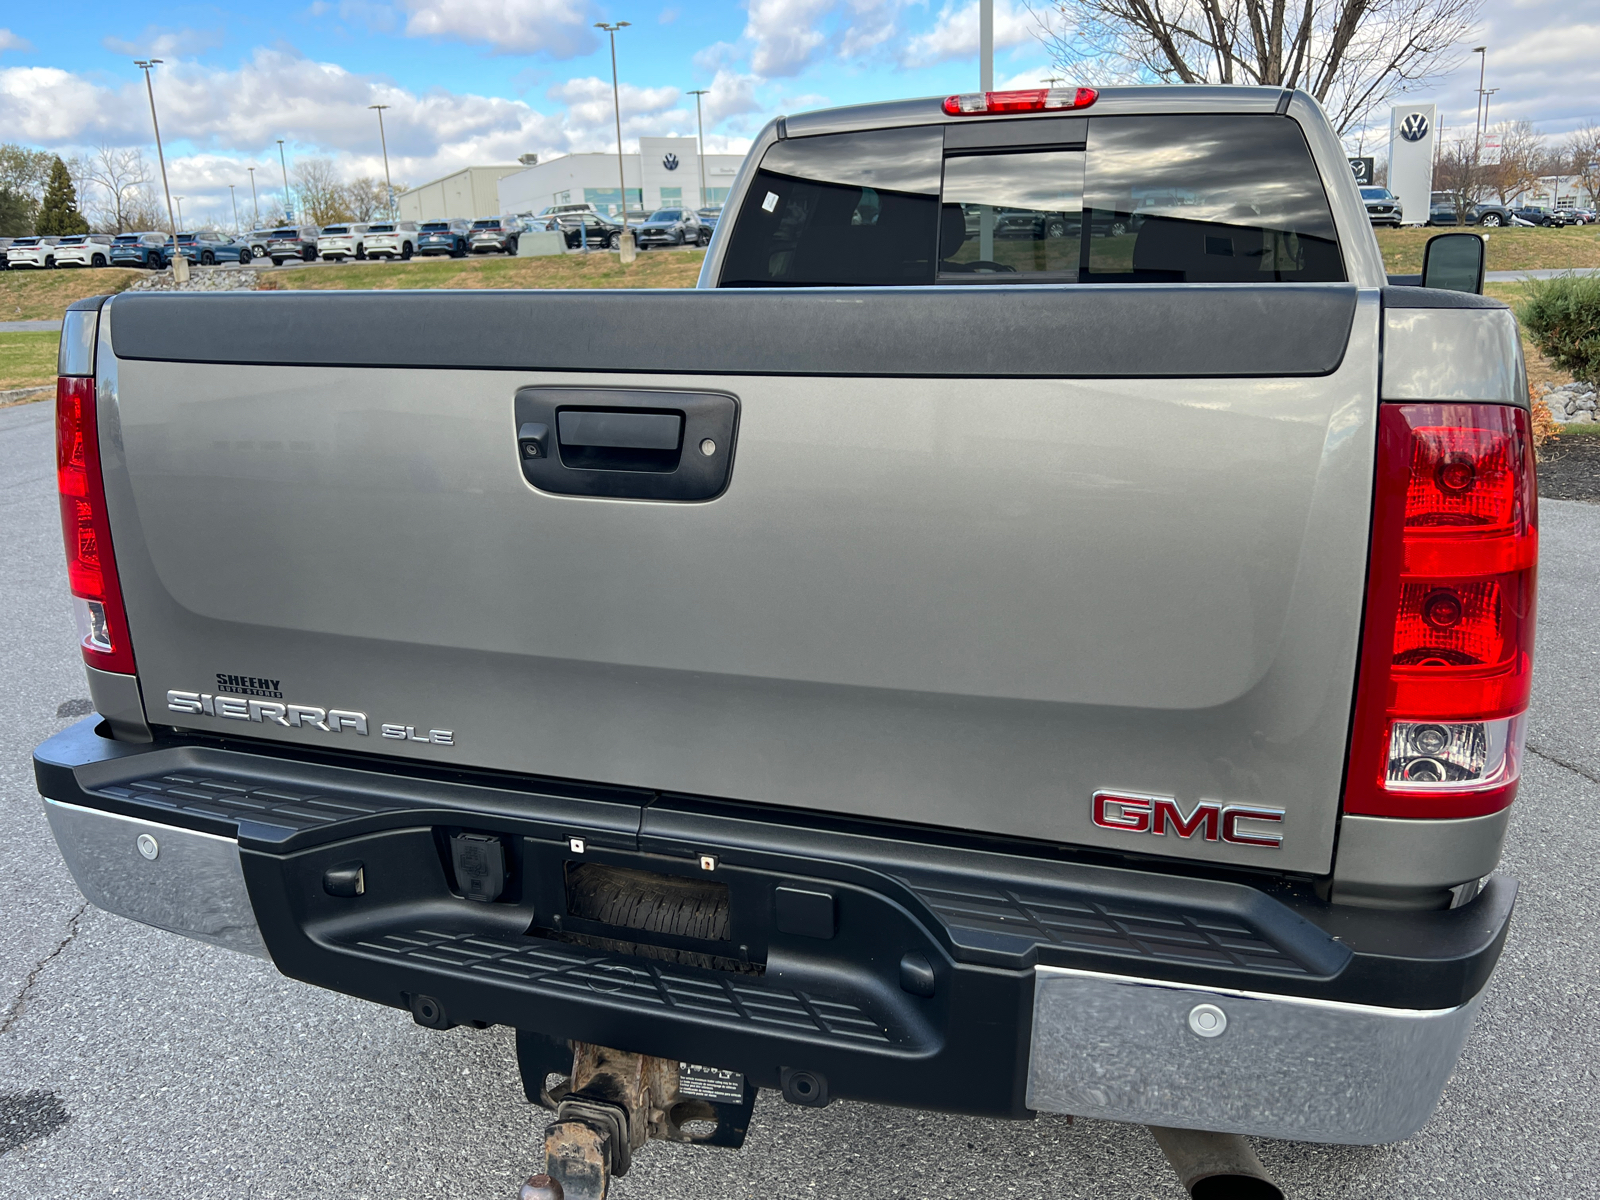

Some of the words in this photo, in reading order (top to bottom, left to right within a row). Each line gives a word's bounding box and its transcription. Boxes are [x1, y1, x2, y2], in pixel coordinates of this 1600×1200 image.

[1400, 112, 1430, 142] VW
[216, 673, 280, 691] SHEEHY
[219, 685, 243, 694] AUTO
[247, 688, 283, 699] STORES
[167, 689, 369, 735] SIERRA
[381, 723, 455, 746] SLE
[1091, 789, 1286, 849] GMC
